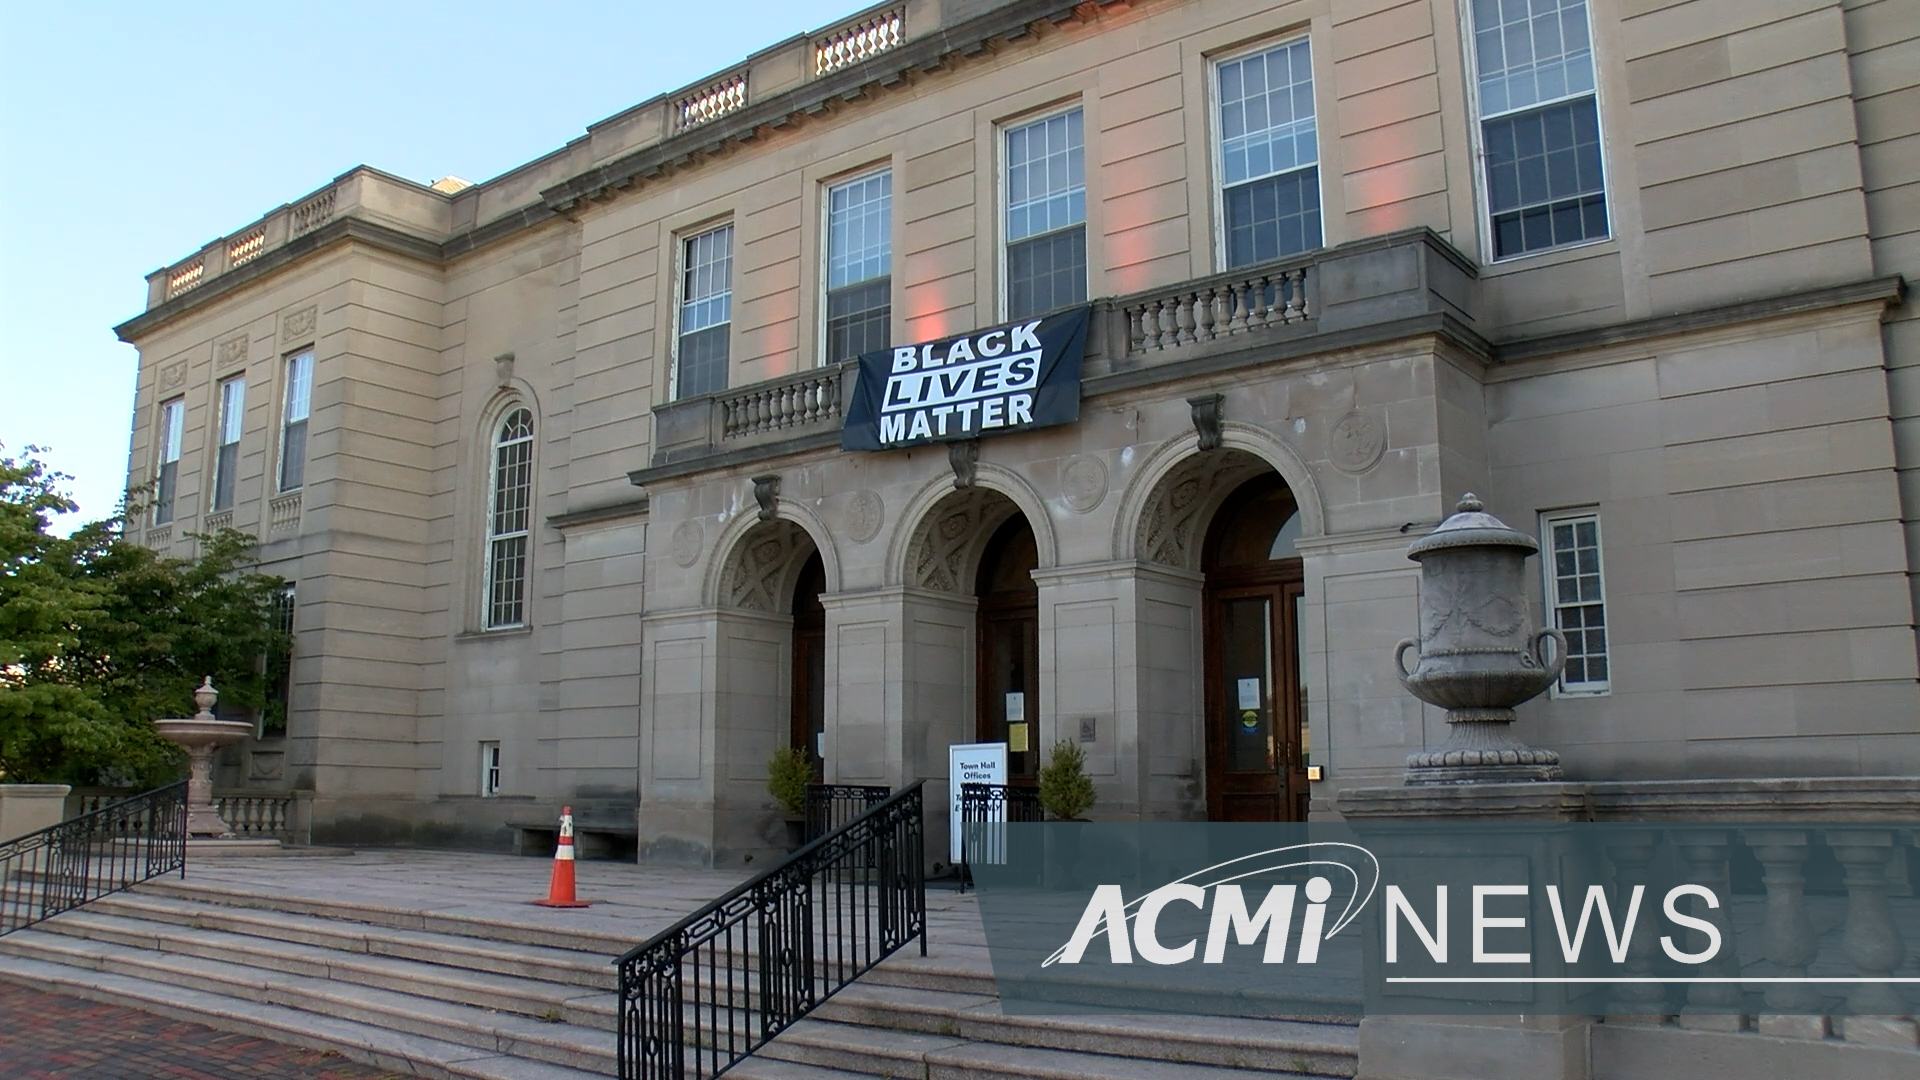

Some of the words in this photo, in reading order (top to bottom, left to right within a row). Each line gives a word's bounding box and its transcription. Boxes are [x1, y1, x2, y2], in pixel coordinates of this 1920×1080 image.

[892, 320, 1042, 374] BLACK
[887, 356, 1036, 407] LIVES
[879, 393, 1034, 444] MATTER
[960, 762, 979, 770] Town
[980, 761, 996, 769] Hall
[964, 771, 991, 780] Offices
